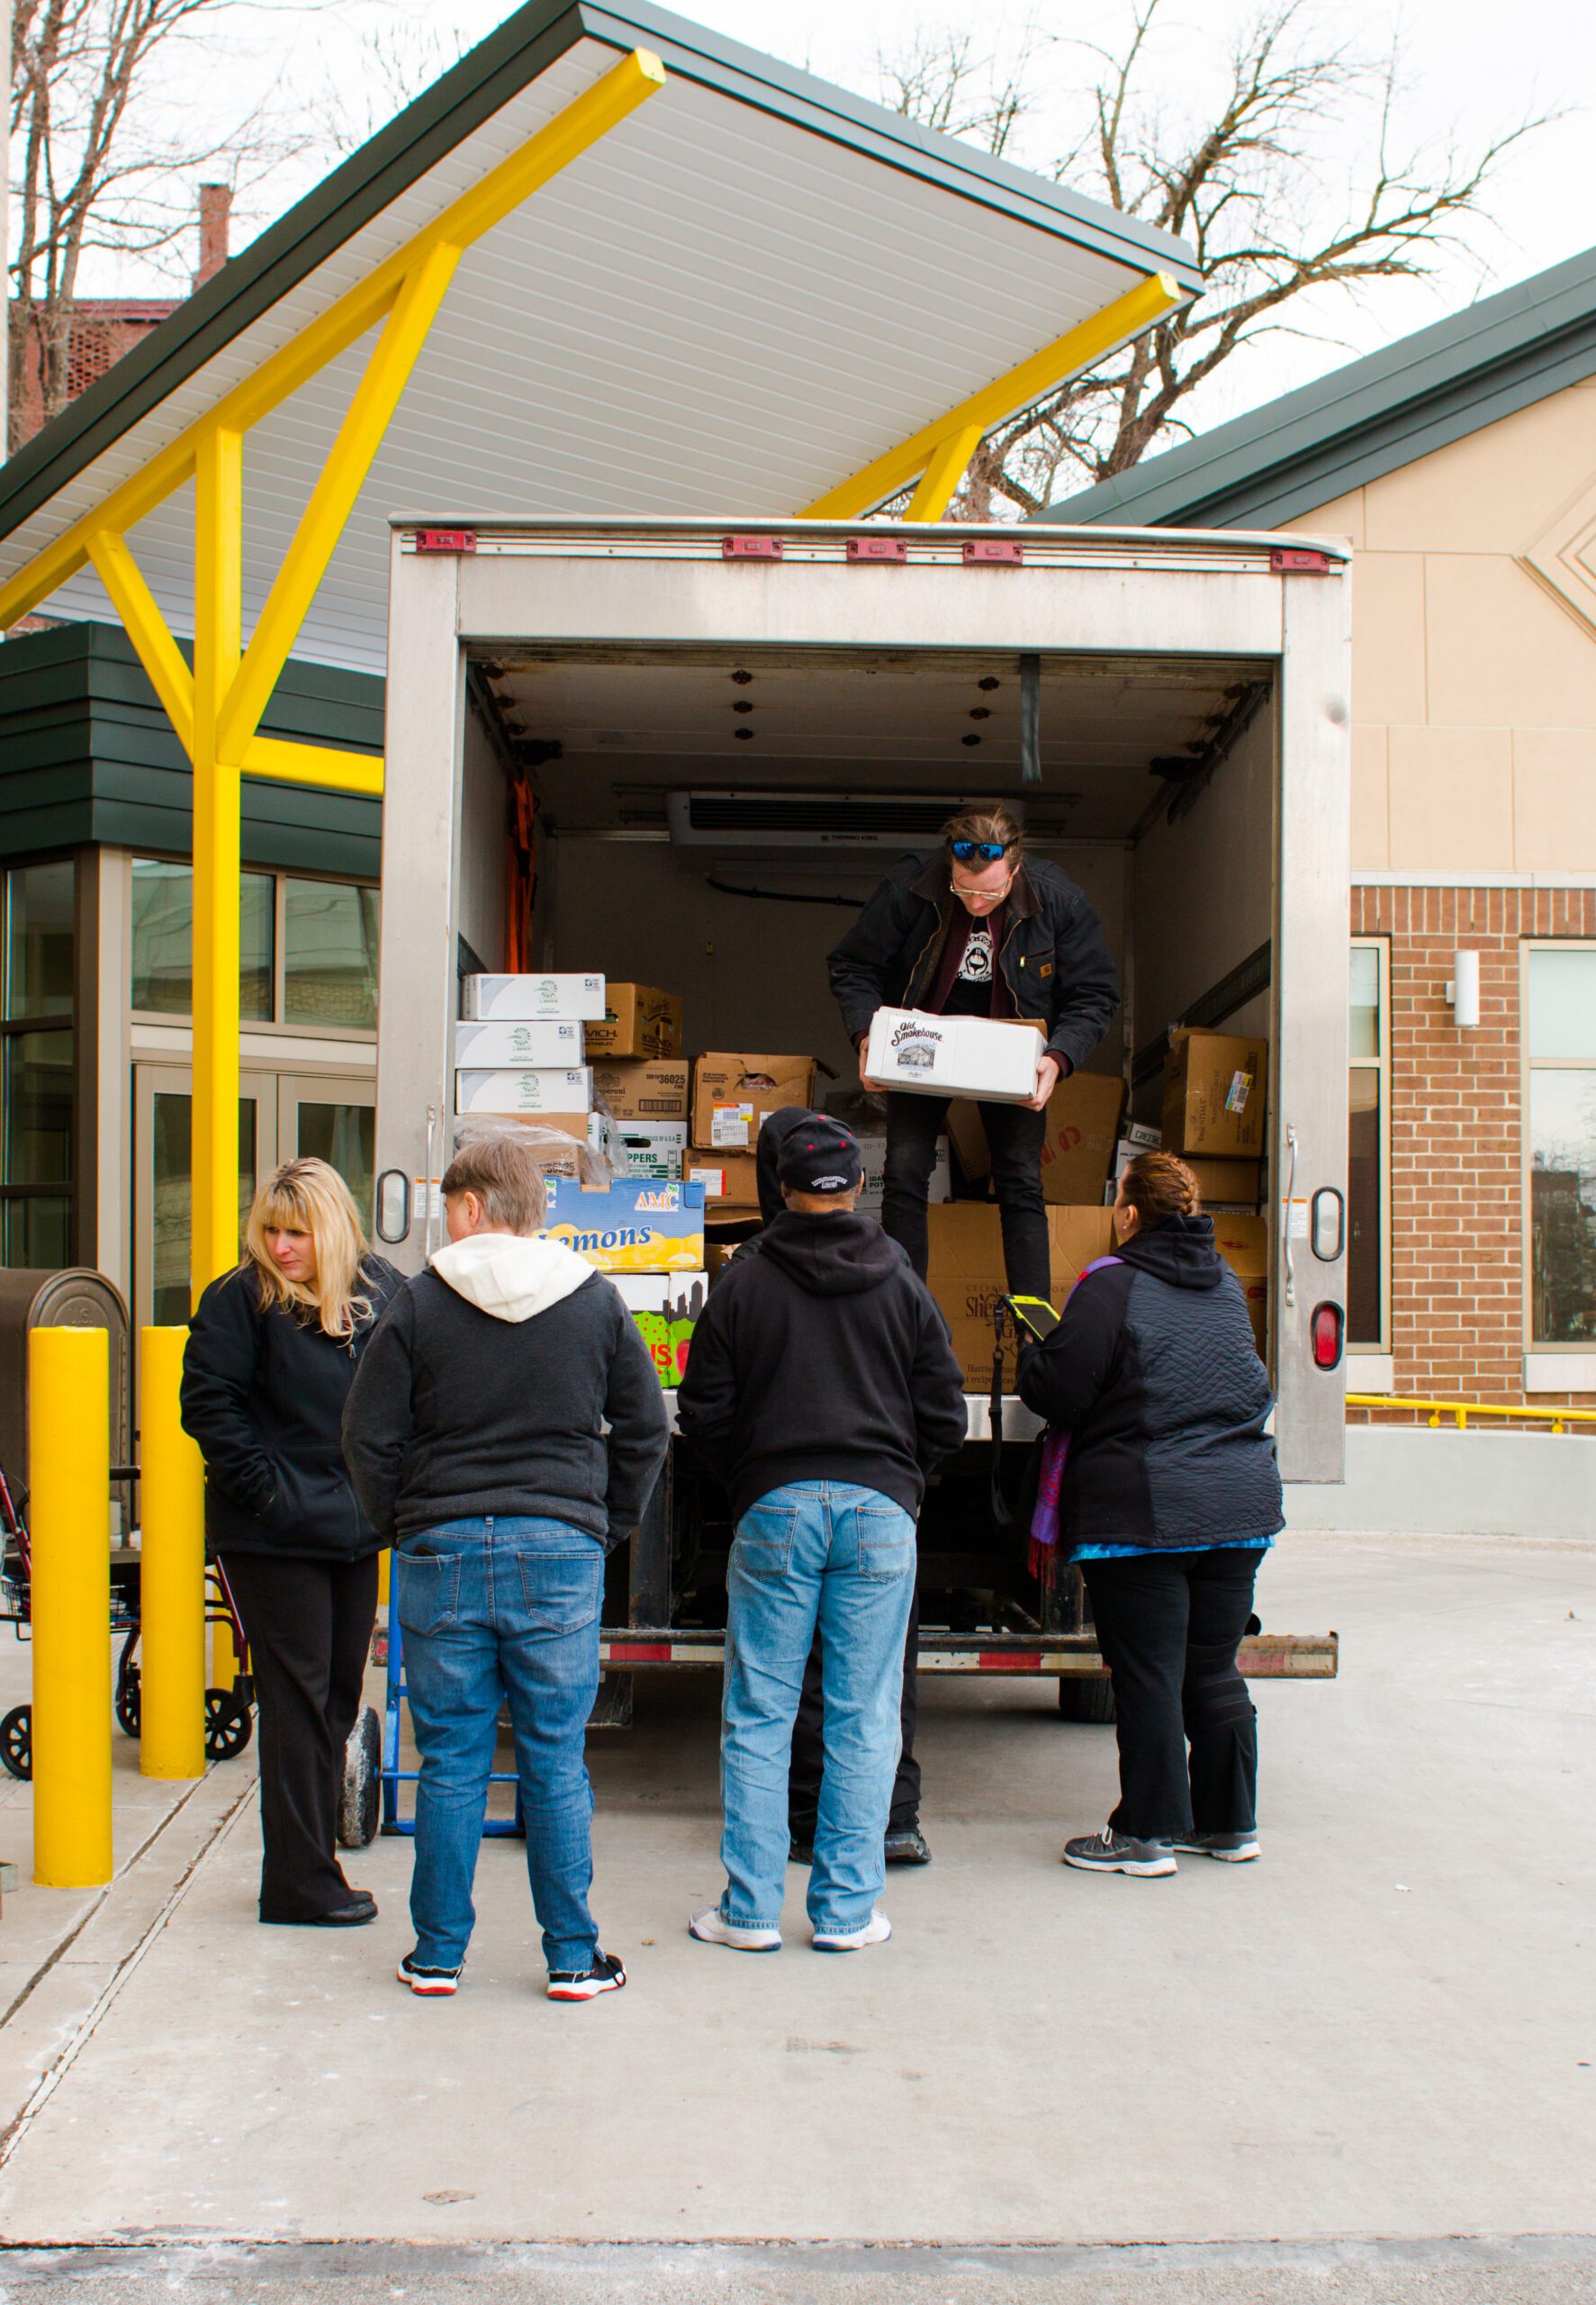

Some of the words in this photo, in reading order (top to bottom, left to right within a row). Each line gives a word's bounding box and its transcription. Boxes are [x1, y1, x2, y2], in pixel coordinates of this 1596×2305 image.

[900, 1021, 916, 1032] Old
[891, 1027, 942, 1047] Smokehouse
[658, 1074, 686, 1084] 36025
[627, 1153, 658, 1163] PPERS
[636, 1191, 679, 1209] AMC
[538, 1225, 652, 1252] emons
